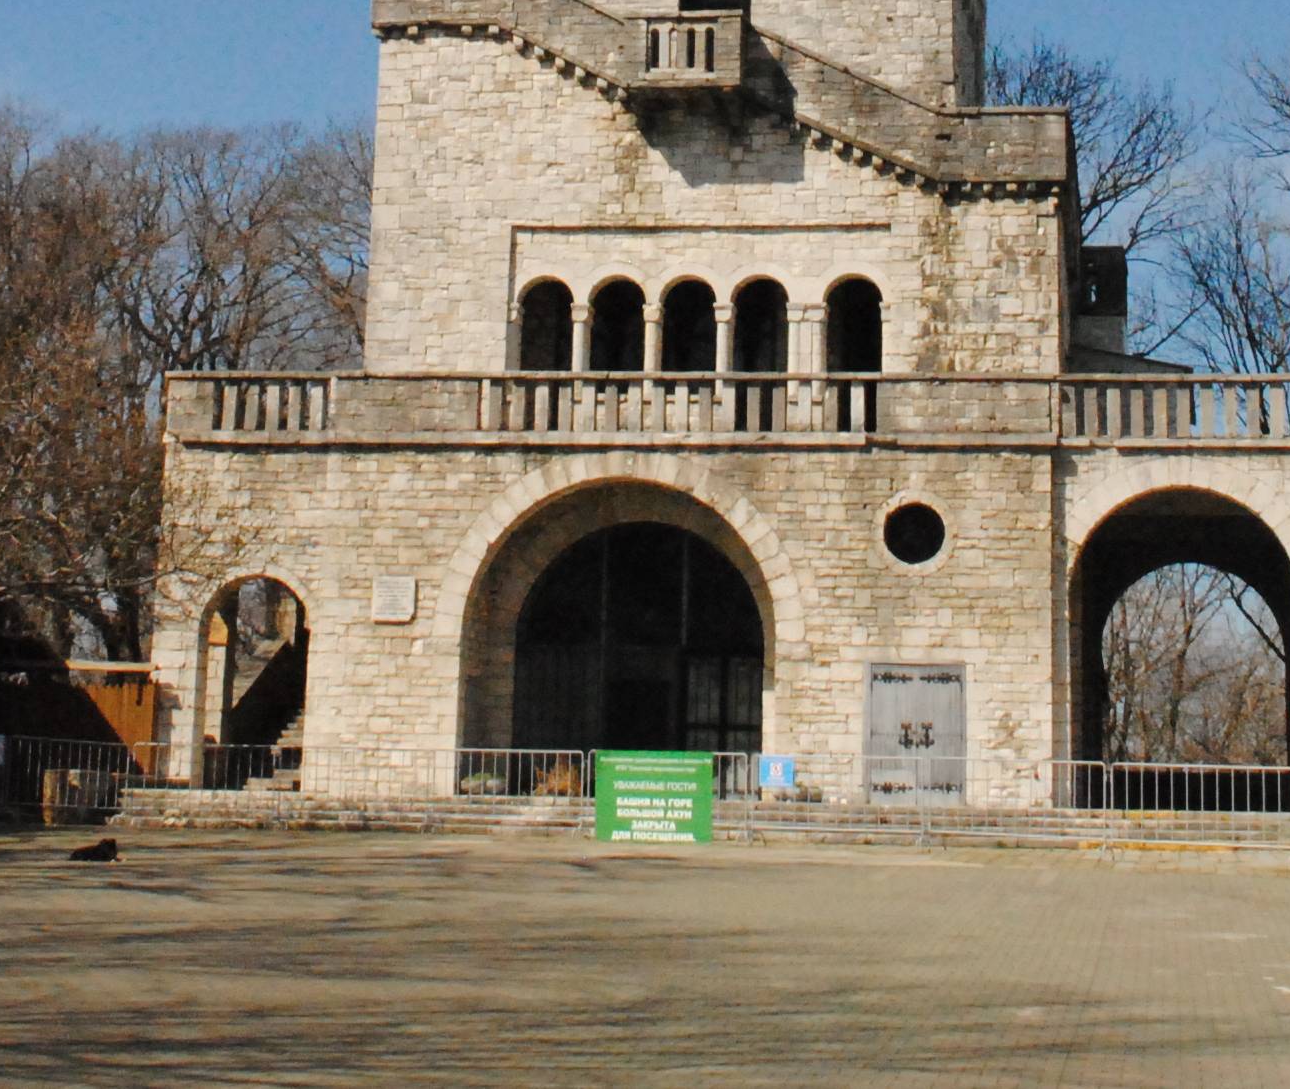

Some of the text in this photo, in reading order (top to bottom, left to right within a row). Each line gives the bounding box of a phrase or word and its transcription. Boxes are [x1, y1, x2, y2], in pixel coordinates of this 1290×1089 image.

[613, 781, 665, 791] УВАЖАЕМЫЕ
[616, 797, 694, 808] БАШНЯ НА ГОРЕ
[617, 808, 693, 820] БОЛЬШОЙ АХУН
[631, 820, 676, 831] ЗАКРЫТА
[611, 830, 631, 841] ДЛЯ
